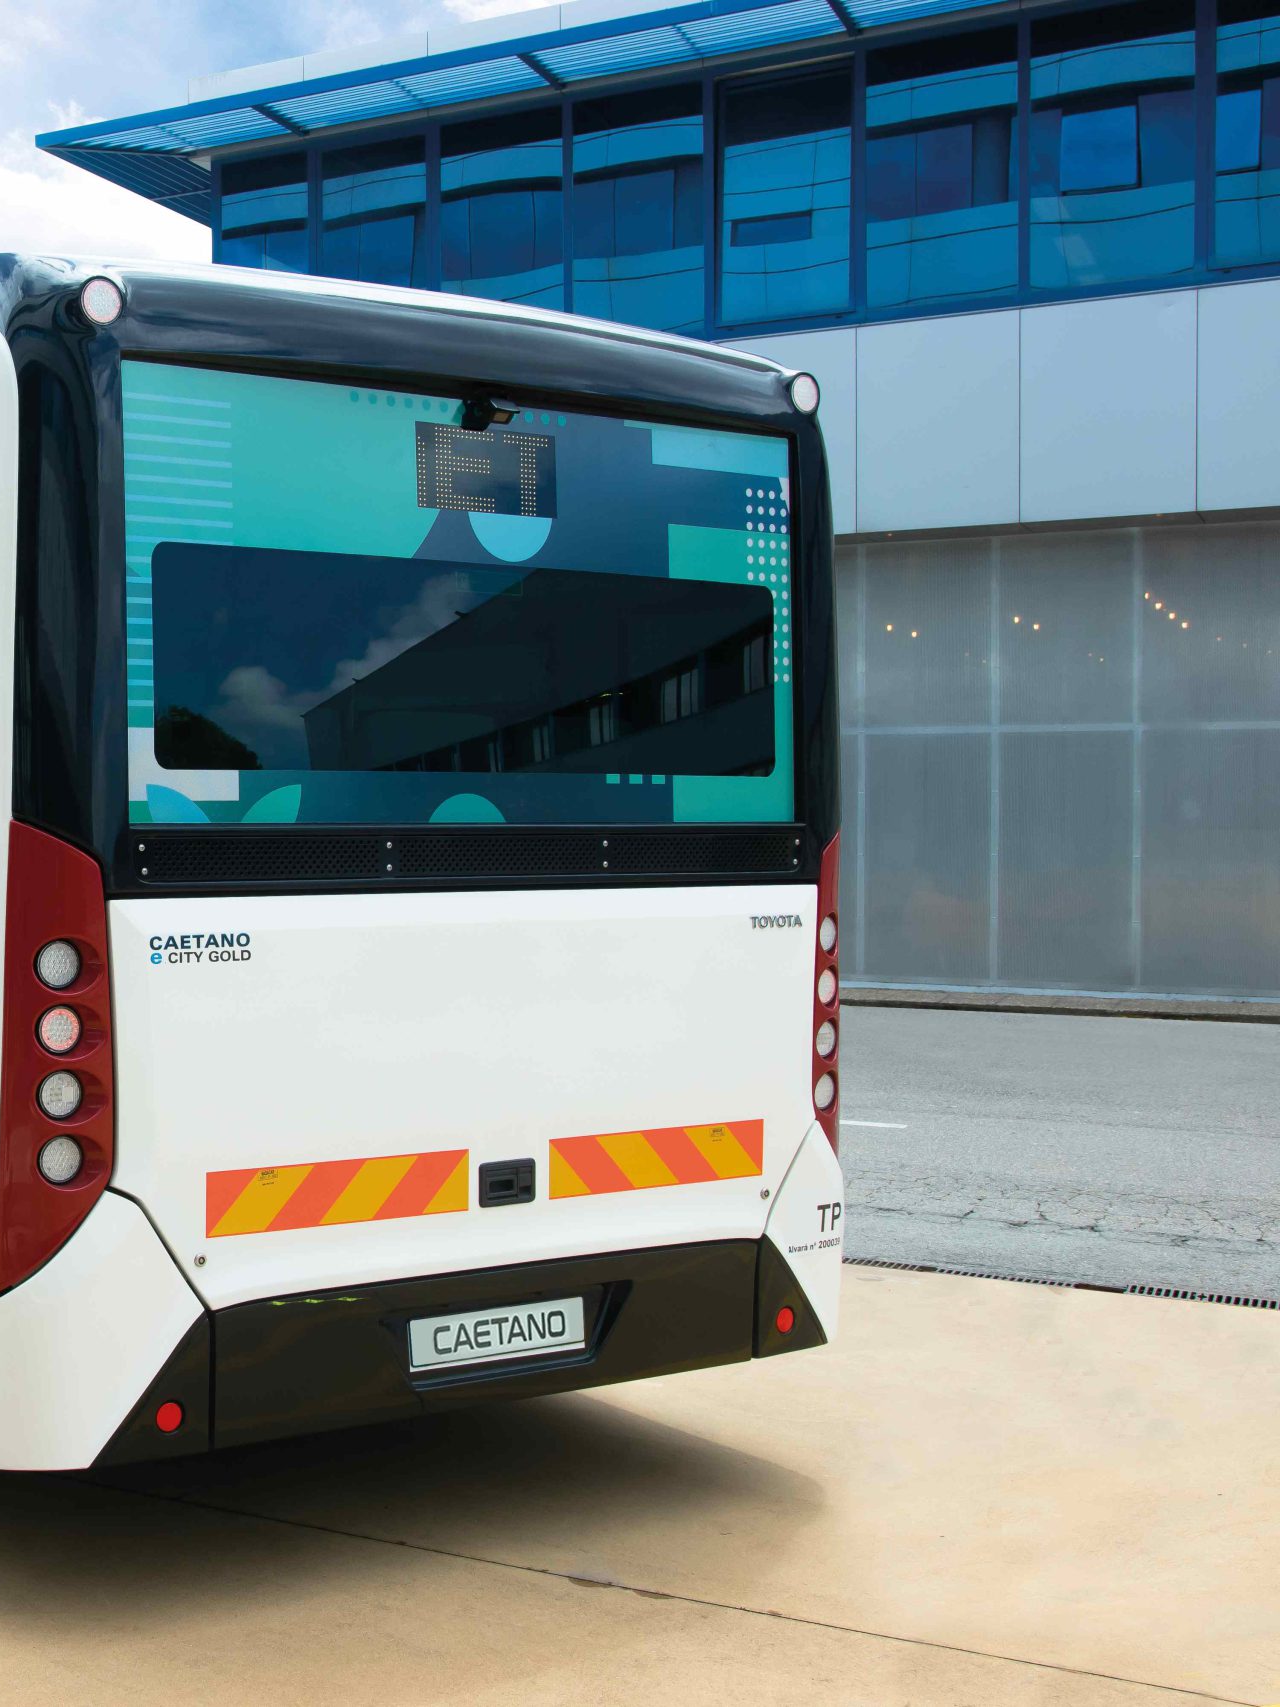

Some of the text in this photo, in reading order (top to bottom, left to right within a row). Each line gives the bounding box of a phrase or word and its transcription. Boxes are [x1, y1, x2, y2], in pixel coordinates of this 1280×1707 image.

[749, 914, 803, 929] TOYOTA
[149, 932, 251, 951] CAETANO
[168, 951, 203, 964] CITY
[208, 949, 252, 963] GOLD
[816, 1201, 842, 1233] TP
[432, 1309, 566, 1356] CAETANO
